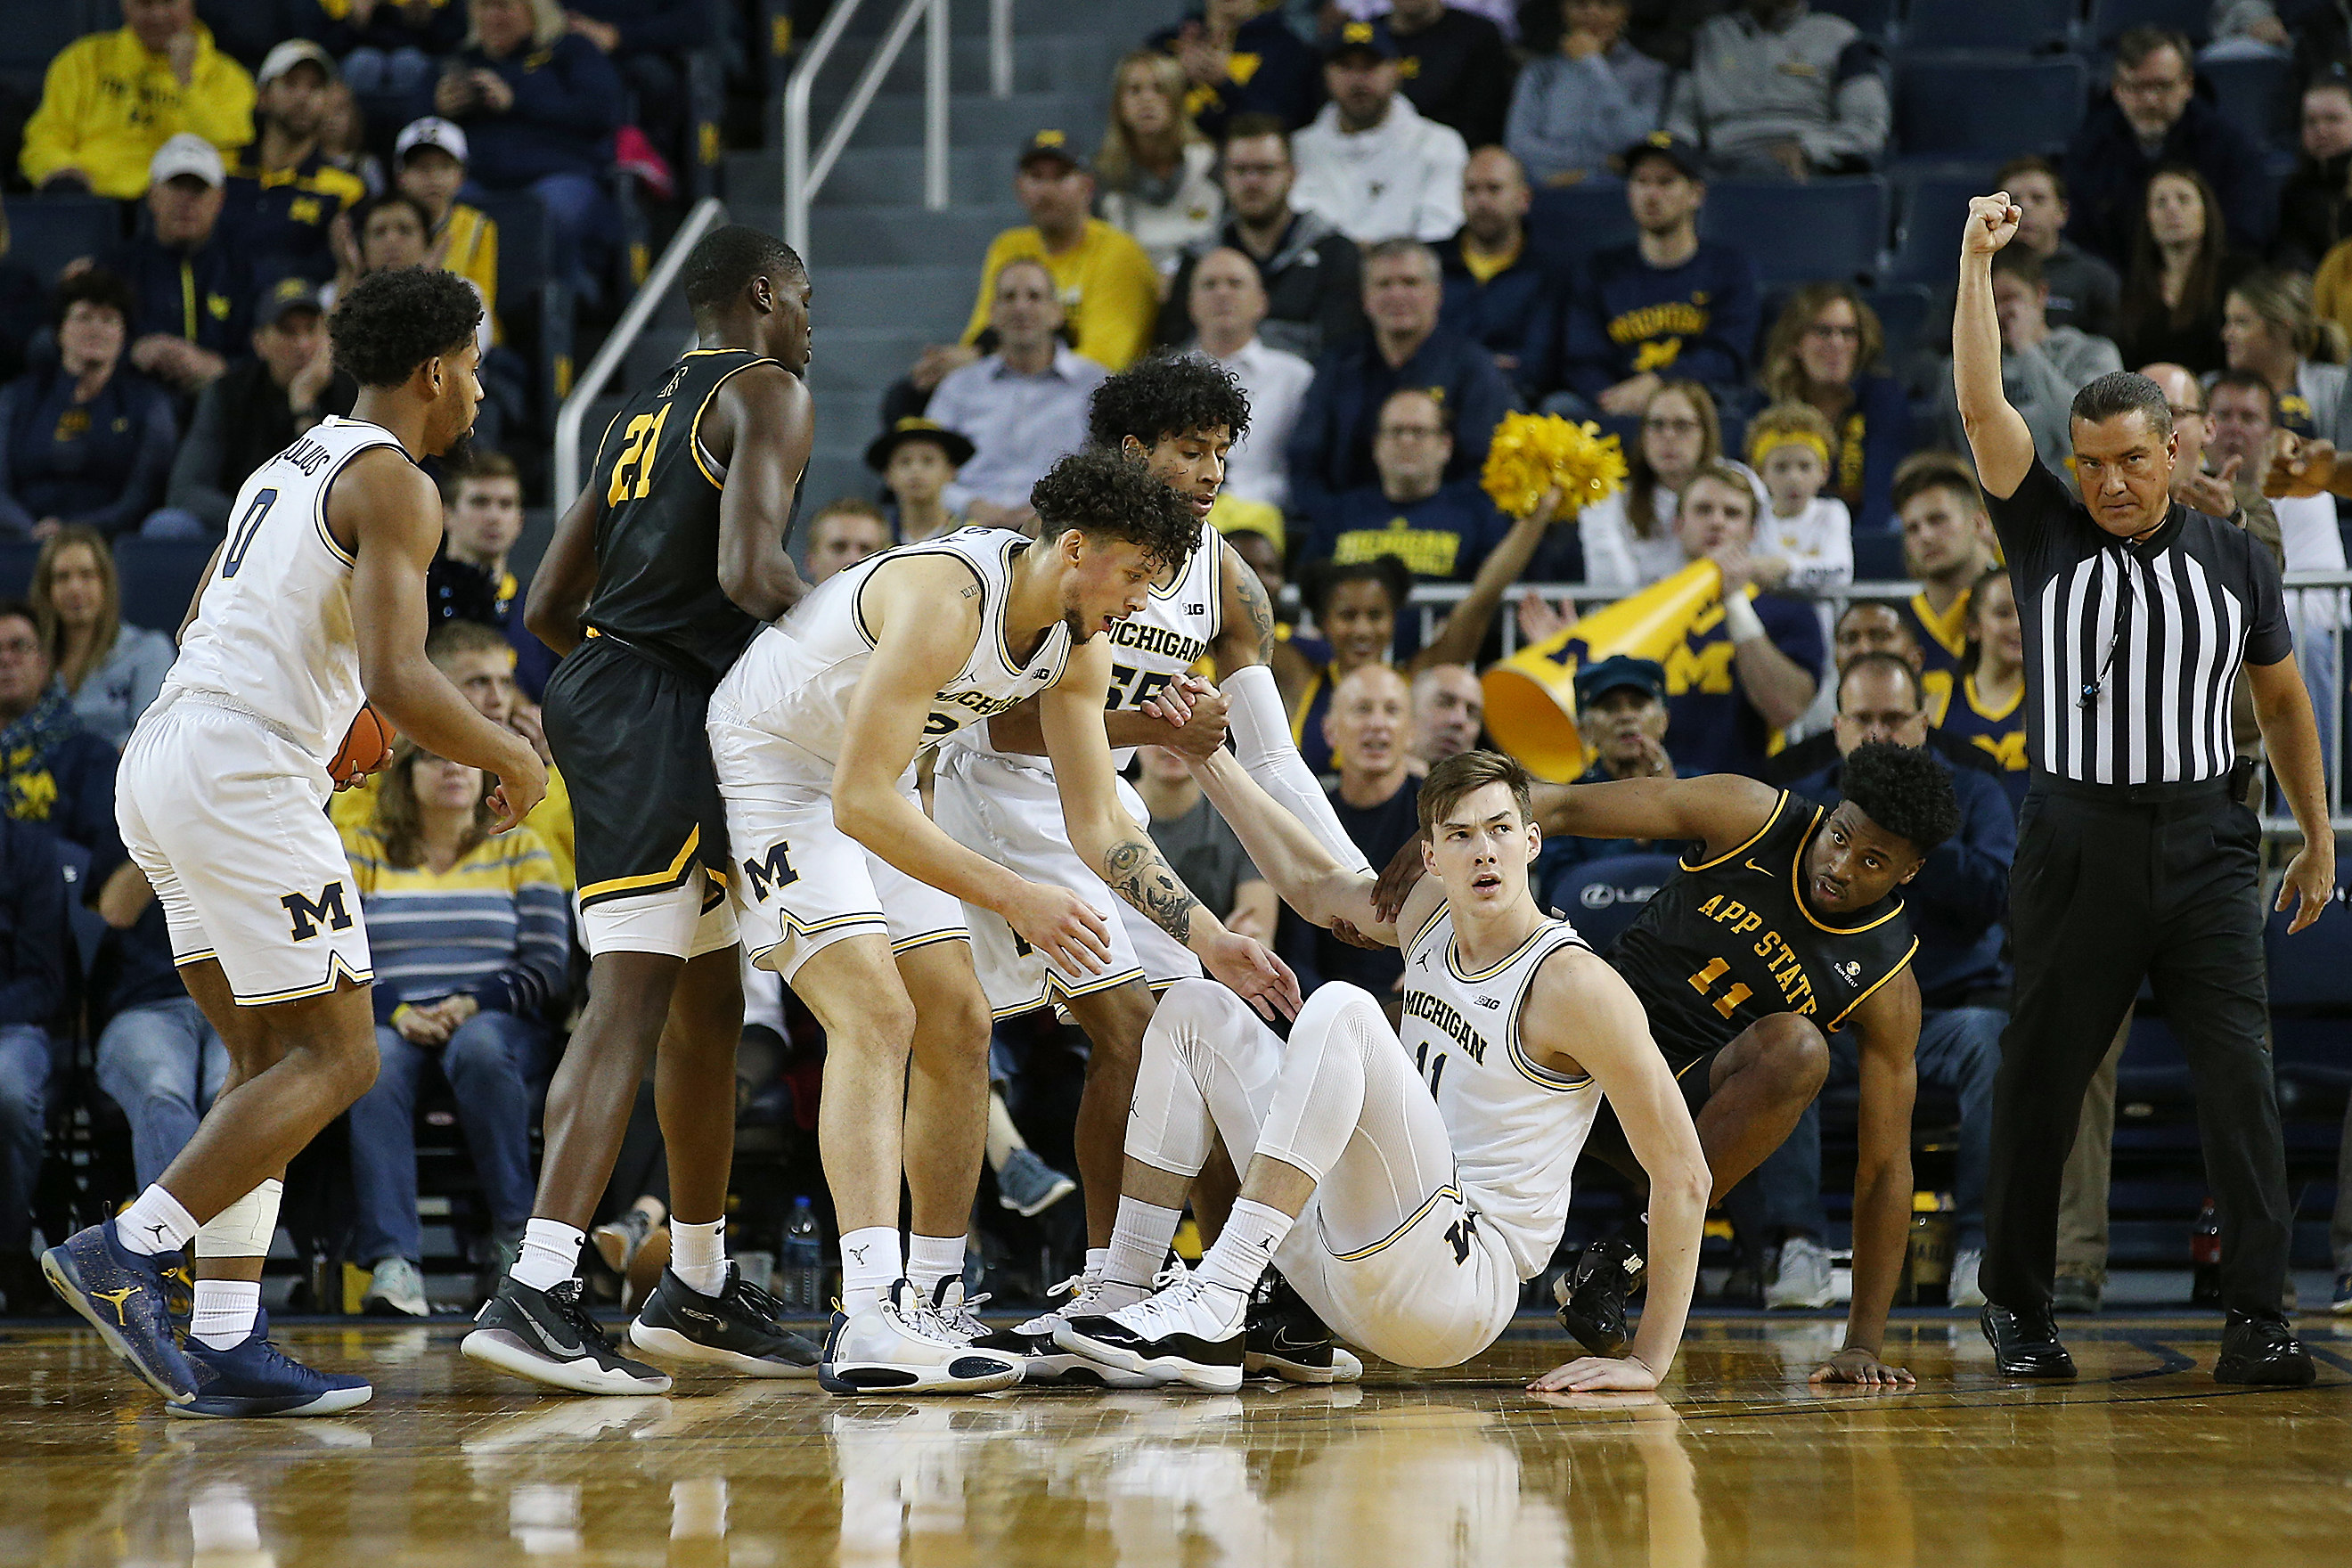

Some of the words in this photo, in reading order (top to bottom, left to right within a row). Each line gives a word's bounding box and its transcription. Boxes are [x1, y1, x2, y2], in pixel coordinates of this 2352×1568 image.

[272, 437, 331, 477] ULIUS
[607, 402, 673, 508] 21
[223, 486, 279, 579] 0
[1109, 621, 1205, 664] ICHIGAN
[1667, 640, 1735, 695] M
[742, 839, 801, 904] M
[280, 879, 354, 943] M
[1696, 894, 1763, 935] APP
[1753, 930, 1818, 1015] STATE
[1687, 956, 1754, 1019] 11
[1403, 989, 1489, 1067] MICHIGAN
[1416, 1040, 1449, 1105] 11
